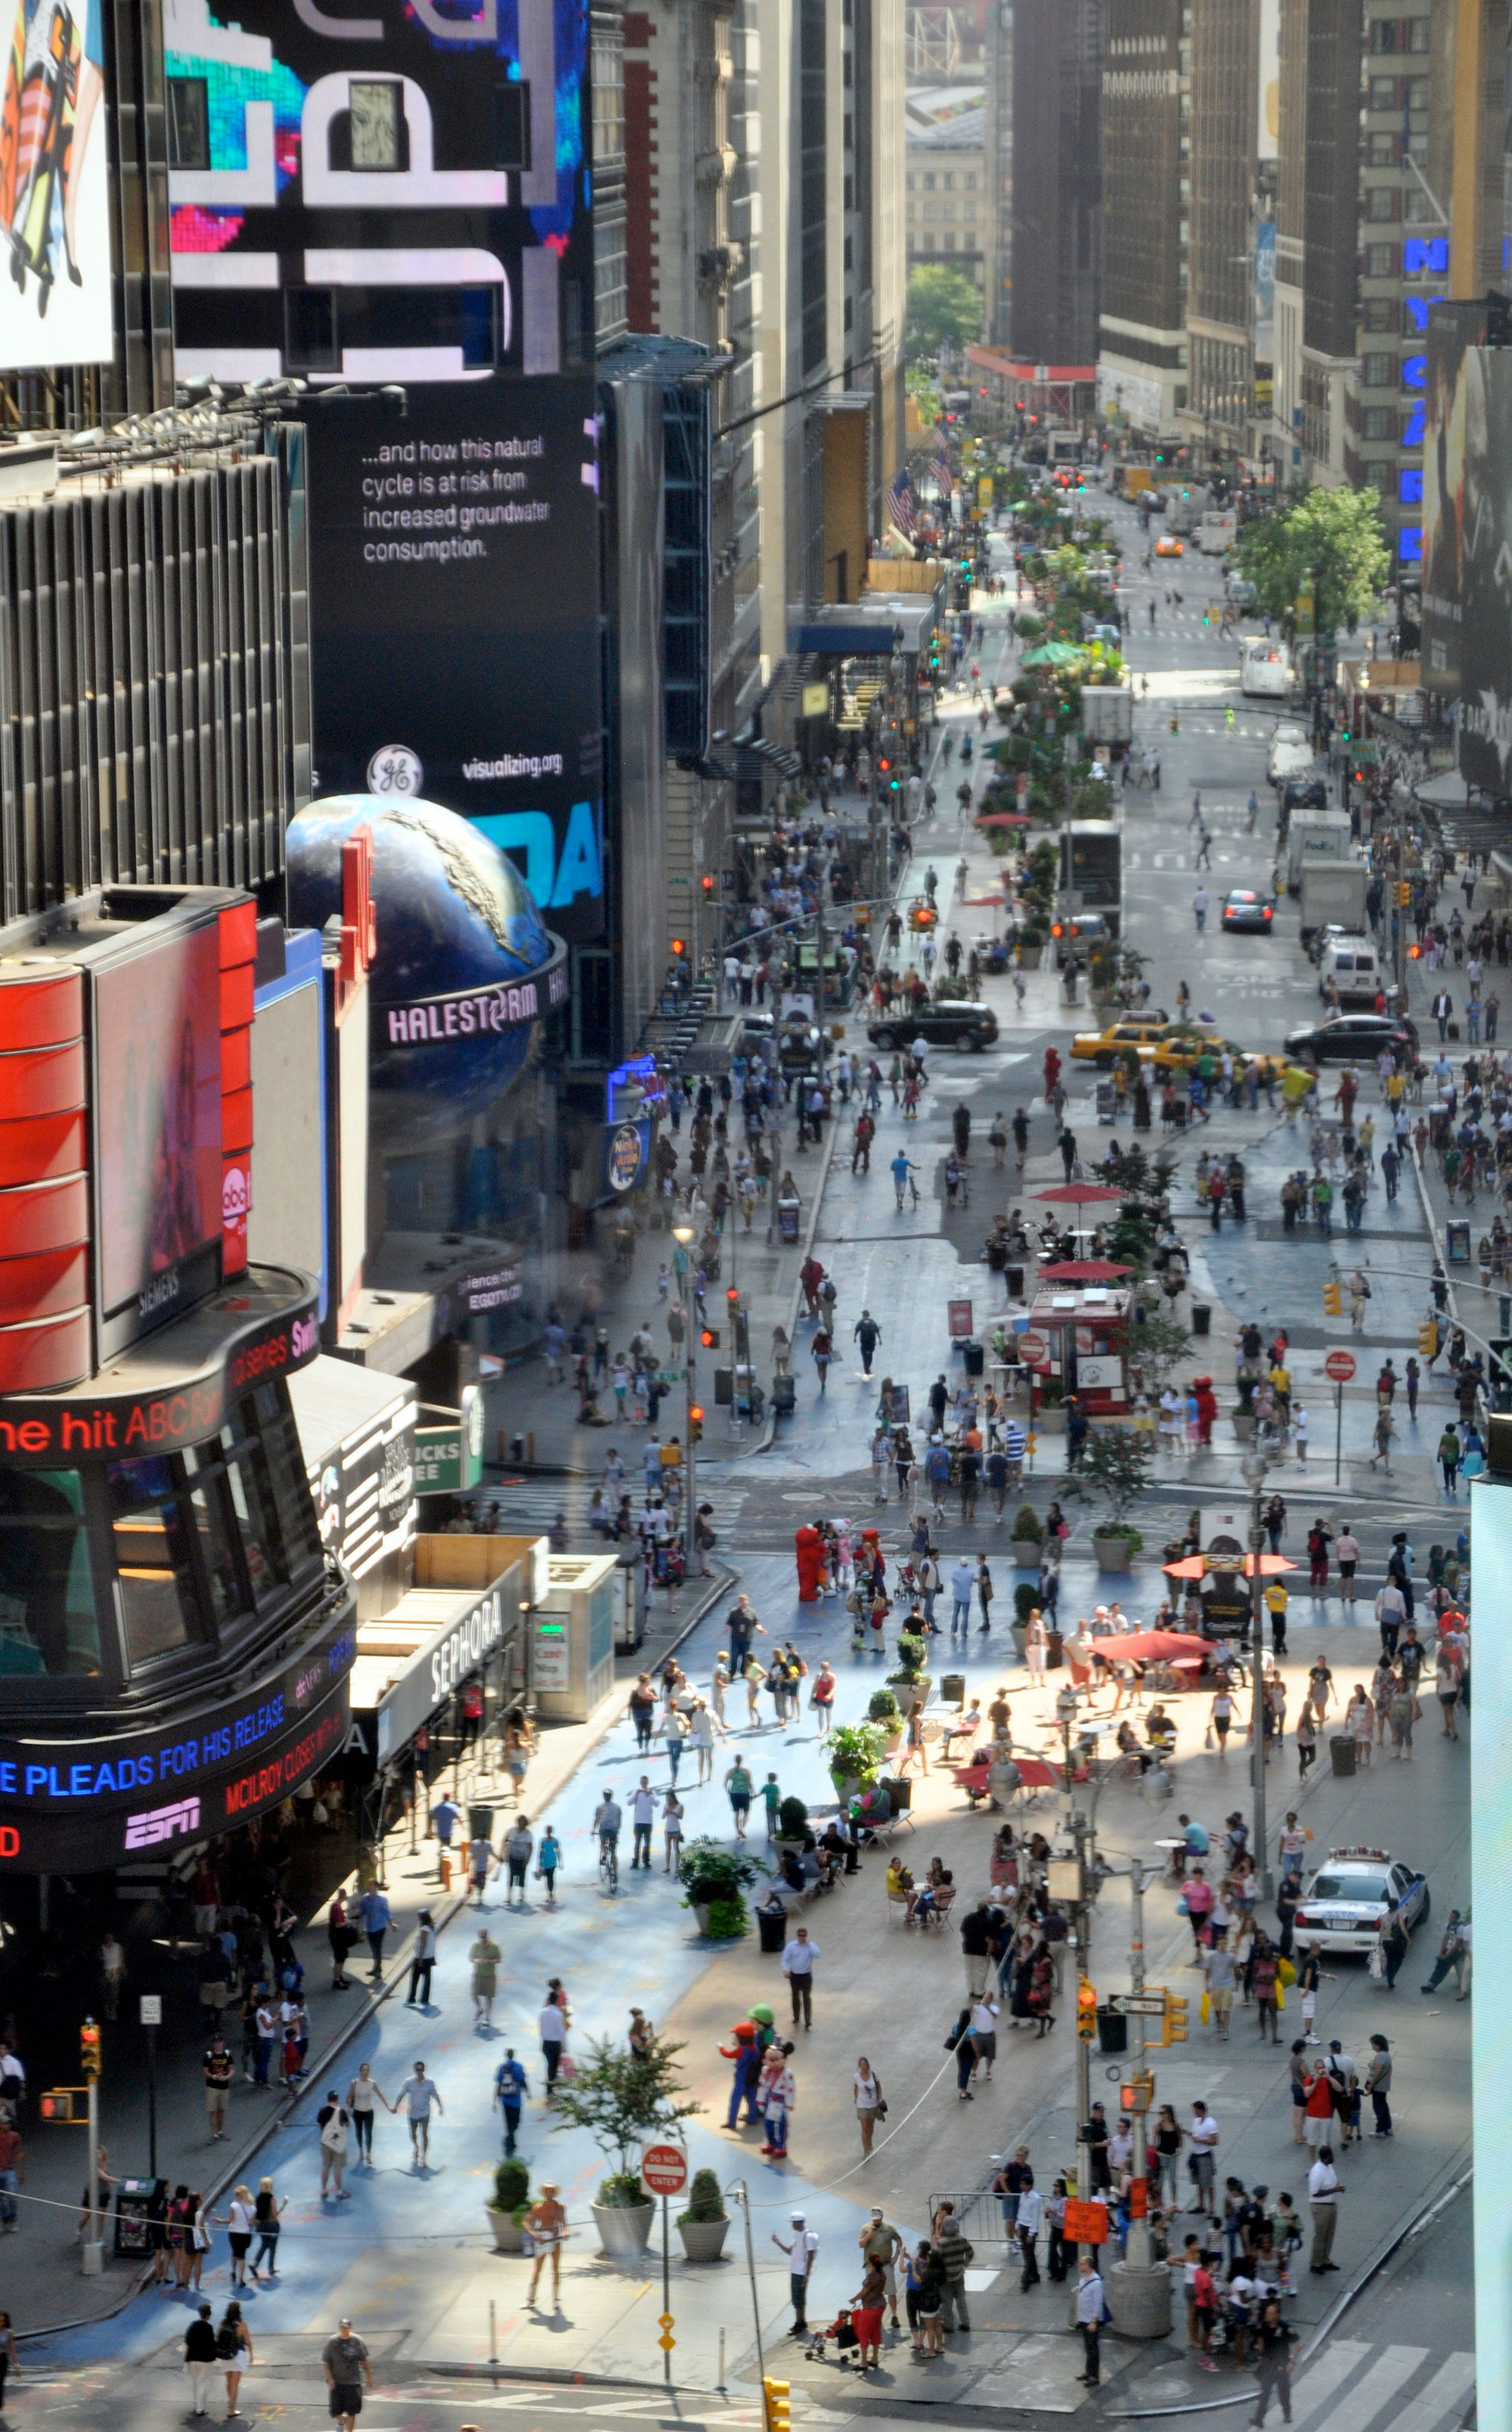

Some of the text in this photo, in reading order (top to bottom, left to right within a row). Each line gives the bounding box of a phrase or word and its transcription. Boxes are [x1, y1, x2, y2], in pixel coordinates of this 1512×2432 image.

[420, 440, 457, 462] how
[461, 437, 491, 459] this
[494, 435, 544, 457] natural
[362, 468, 528, 501] cycle is at risk from
[363, 500, 551, 532] increased groundwater
[363, 535, 487, 565] consumption.
[1249, 651, 1283, 663] FedEx
[462, 753, 562, 779] visualizing.org
[222, 1185, 246, 1210] abc
[138, 1268, 178, 1317] SIEMENS
[61, 1410, 118, 1451] hit
[124, 1395, 187, 1445] ABC
[431, 1591, 503, 1702] SEPHORA
[26, 1755, 154, 1796] PLEADS
[159, 1741, 199, 1780] FOR
[203, 1726, 231, 1762] HIS
[234, 1693, 285, 1751] RELEASE
[125, 1796, 201, 1850] ESPN
[225, 1758, 284, 1815] MCILROY
[1116, 1998, 1160, 2012] ONE WAY
[649, 2153, 678, 2164] DO NOT
[652, 2176, 677, 2187] ENTER
